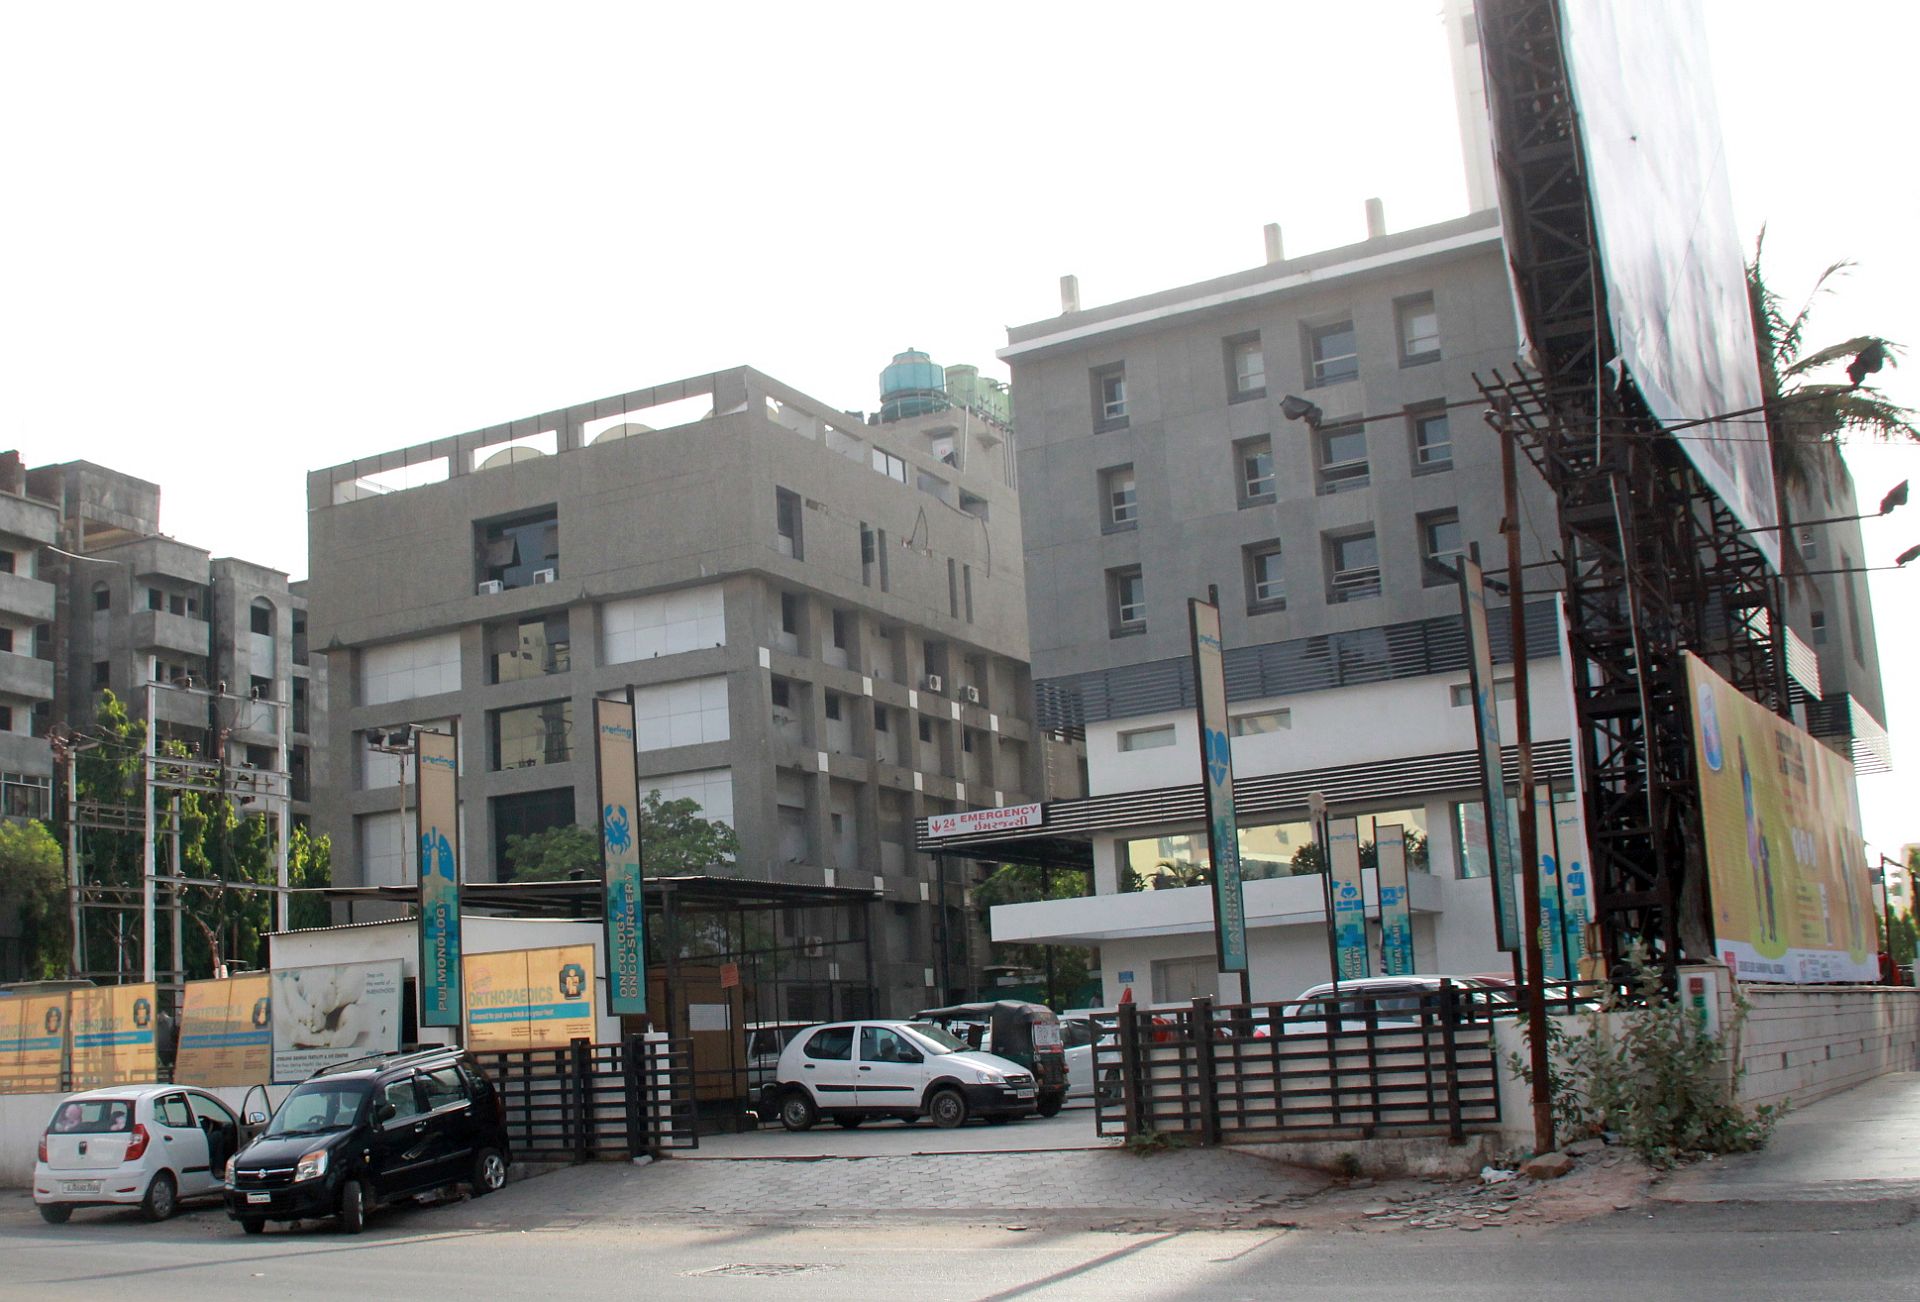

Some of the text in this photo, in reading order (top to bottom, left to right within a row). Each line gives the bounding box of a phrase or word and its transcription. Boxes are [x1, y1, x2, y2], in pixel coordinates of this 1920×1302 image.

[943, 805, 1038, 829] 24 EMERGENCY
[436, 900, 448, 1012] PULMONOLOGY
[616, 911, 628, 998] ONCOLOGY
[624, 872, 638, 998] ONCO-SURGERY
[469, 986, 553, 1007] ORTHOPAEDICS
